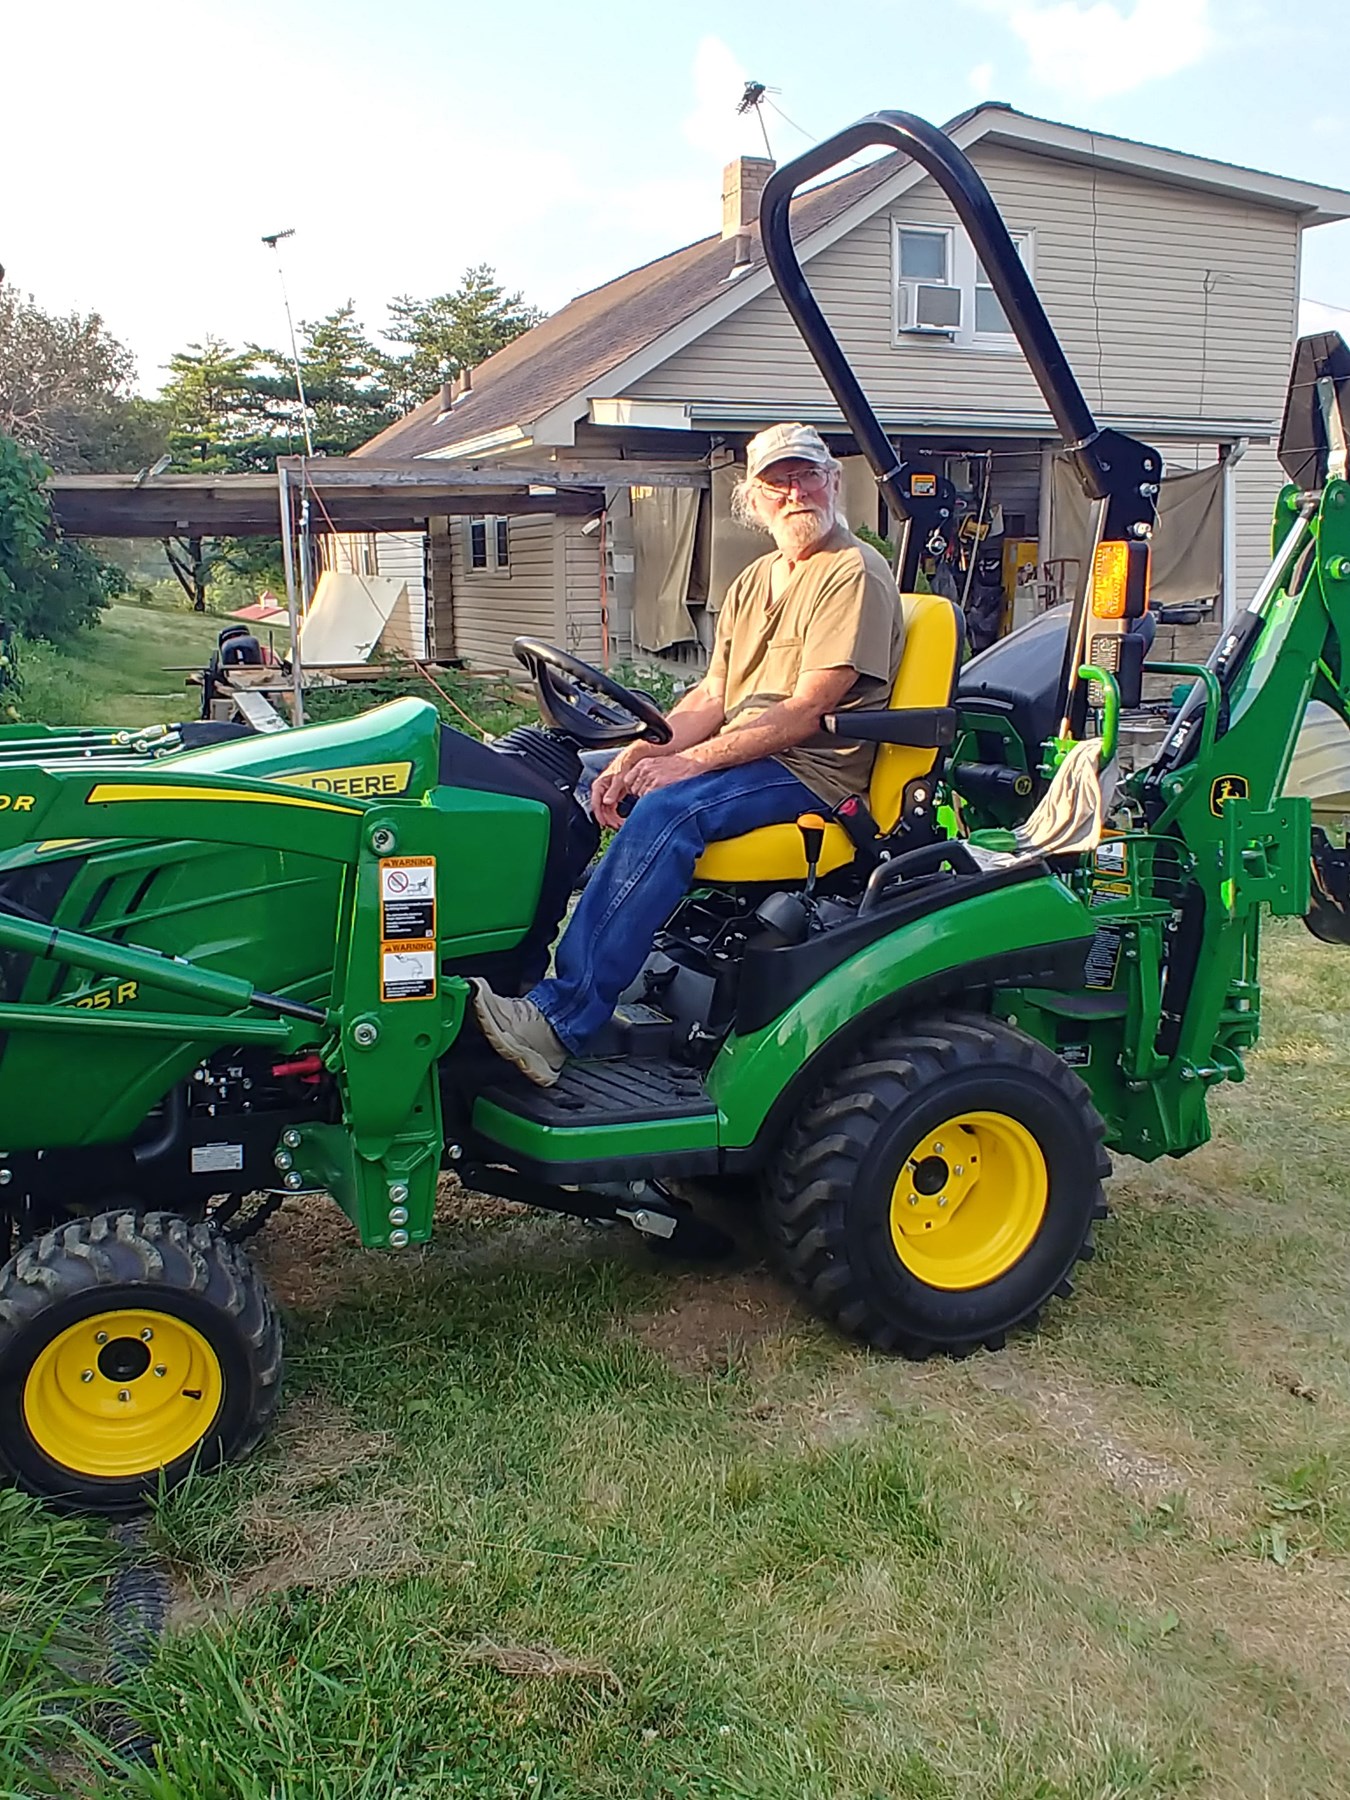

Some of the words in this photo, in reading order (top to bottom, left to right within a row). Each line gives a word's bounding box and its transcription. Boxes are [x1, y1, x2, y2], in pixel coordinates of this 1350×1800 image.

[311, 774, 397, 795] DEERE
[390, 857, 433, 867] WARNING
[391, 942, 433, 951] WARNING
